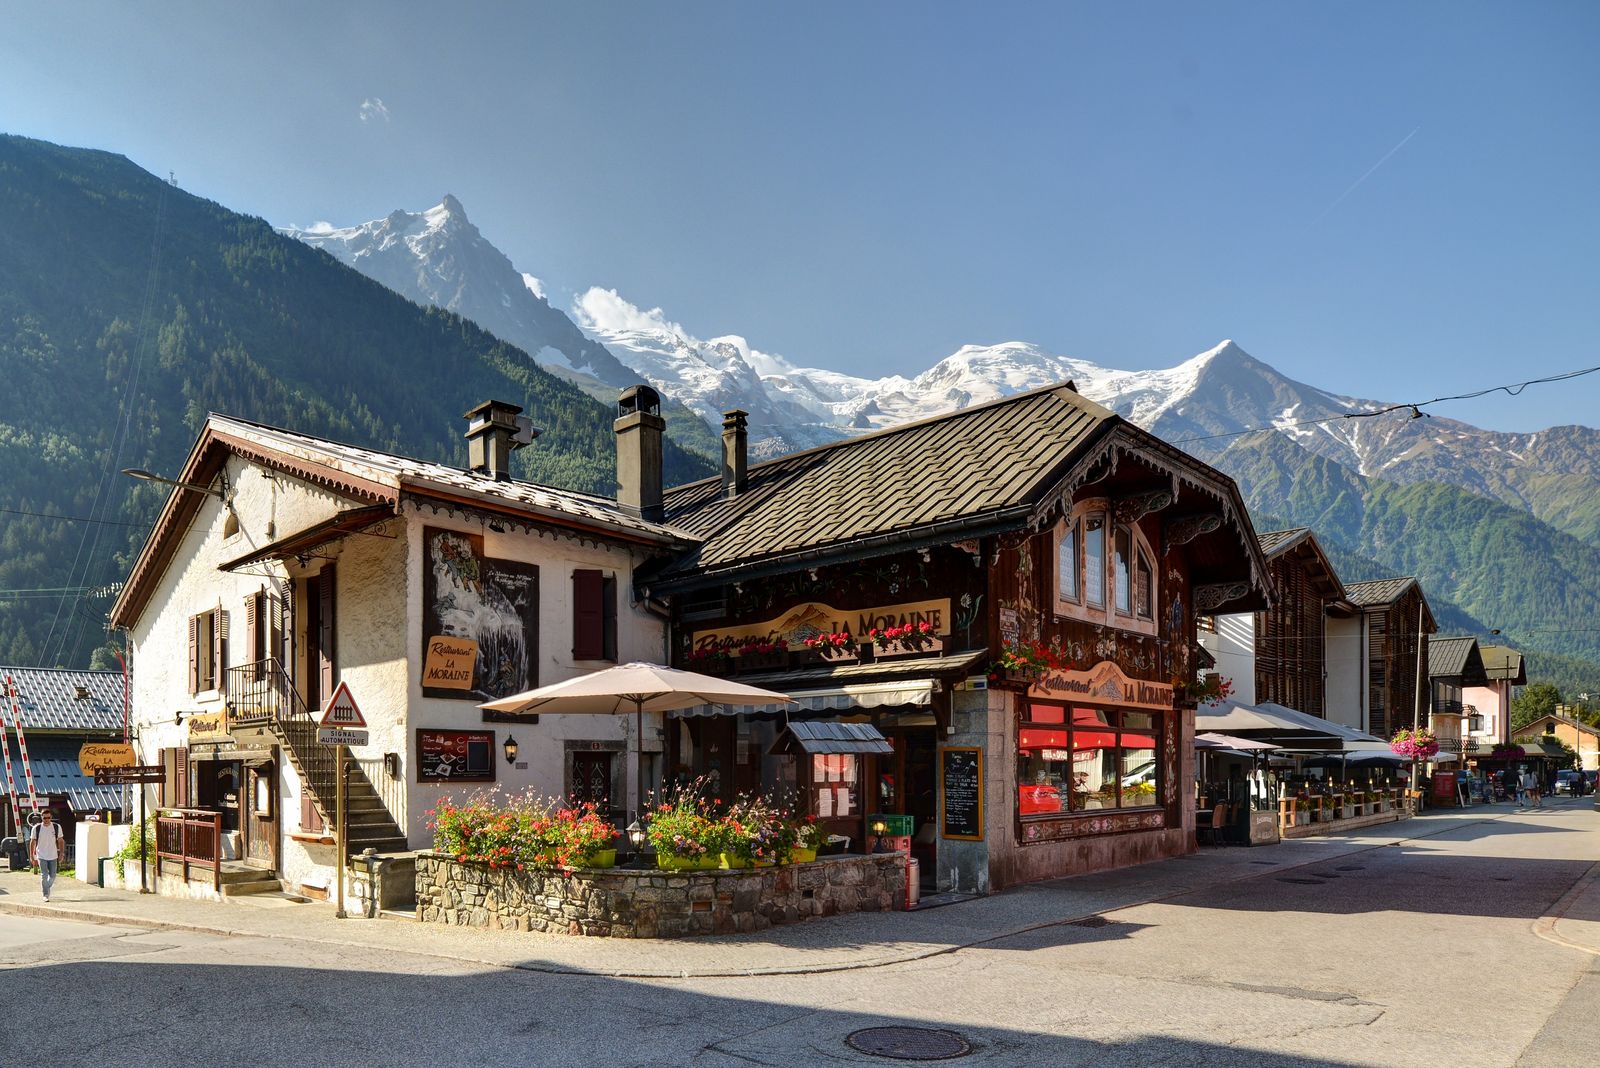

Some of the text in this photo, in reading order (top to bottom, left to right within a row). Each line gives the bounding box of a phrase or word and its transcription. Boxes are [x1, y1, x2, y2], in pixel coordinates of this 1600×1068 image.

[431, 642, 474, 657] Restaurant
[445, 659, 455, 668] LA
[428, 667, 470, 680] MORAINE
[1033, 672, 1094, 695] Restaurant
[1123, 683, 1137, 703] LA
[83, 747, 129, 756] Restaurant
[103, 757, 113, 765] LA
